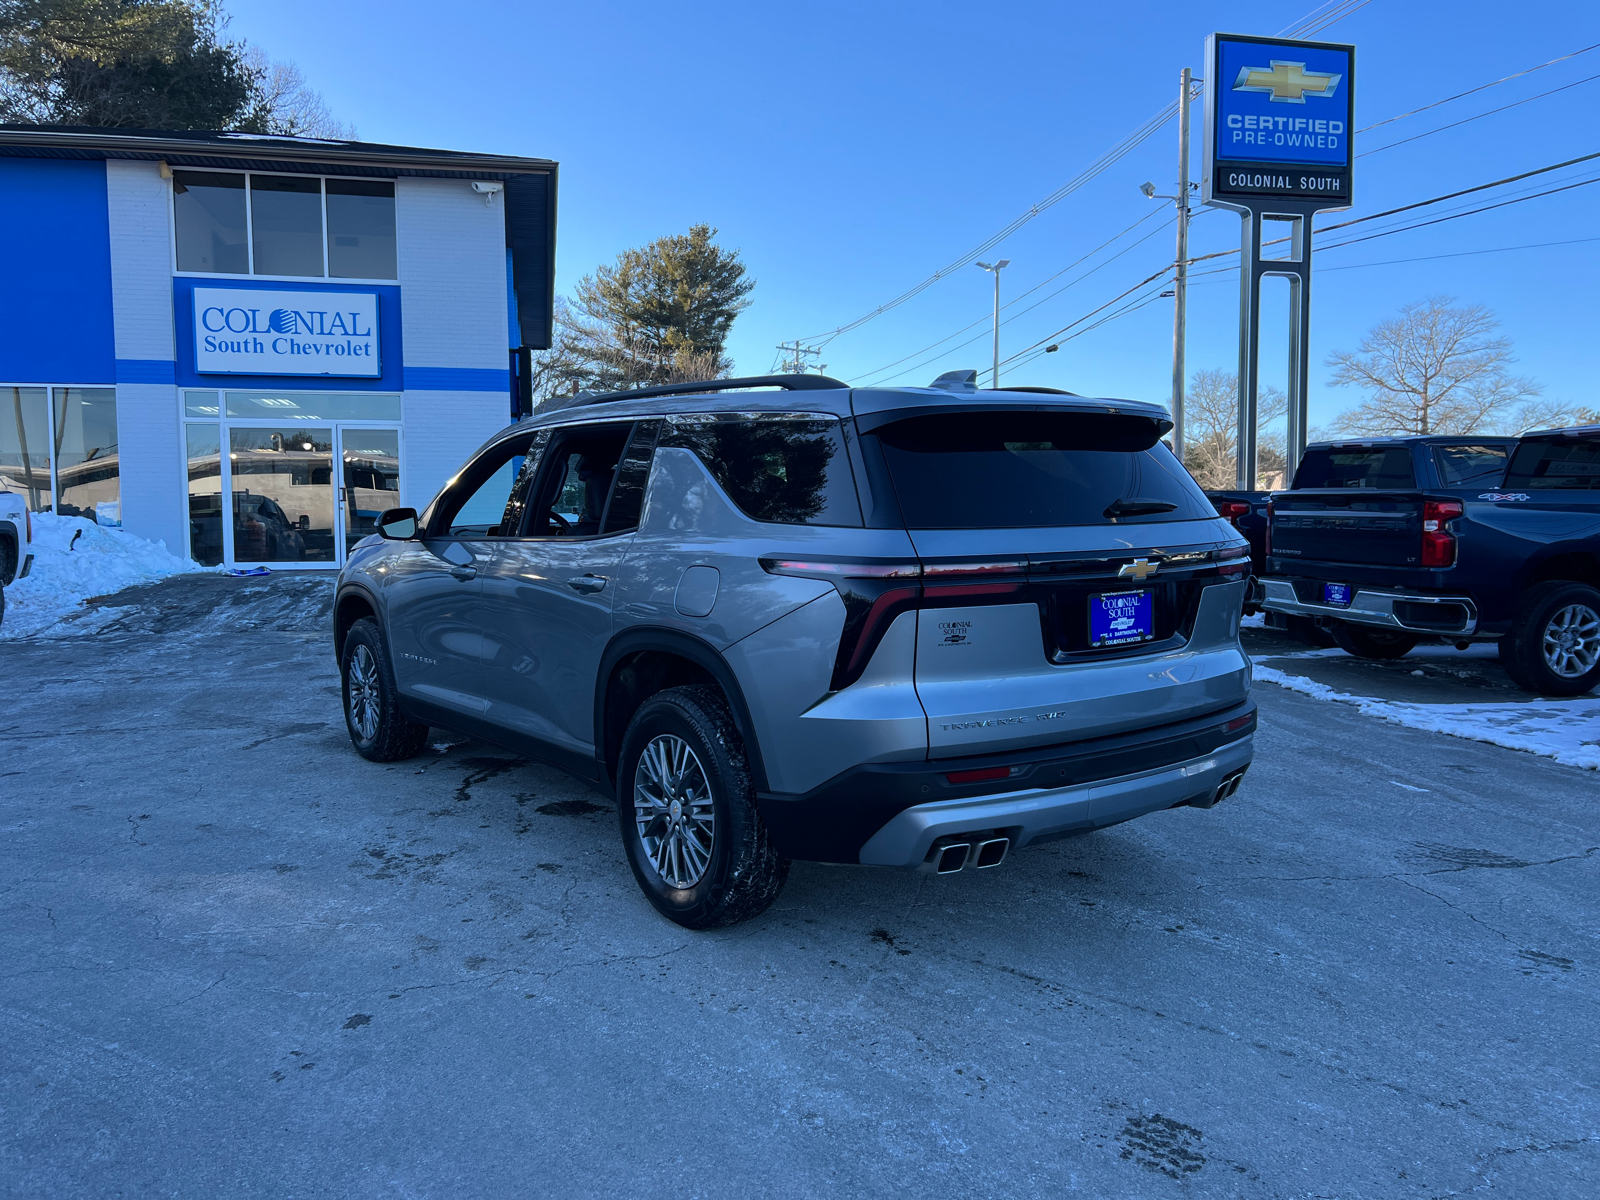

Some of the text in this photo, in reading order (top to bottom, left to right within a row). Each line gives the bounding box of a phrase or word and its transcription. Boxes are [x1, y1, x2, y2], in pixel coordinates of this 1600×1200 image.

[1227, 114, 1344, 134] CERTIFIED
[1232, 131, 1338, 149] PRE-OWNED
[1229, 173, 1340, 191] COLONIAL SOUTH
[202, 306, 371, 337] COLONIAL
[204, 335, 372, 357] South Chevrolet
[1275, 517, 1406, 532] CHEVROLET
[1102, 597, 1140, 609] COLONIAL
[1109, 607, 1135, 618] SOUTH
[938, 621, 973, 630] COLONIAL
[943, 627, 967, 636] SOUTH
[1105, 637, 1126, 646] COLONIAL
[399, 652, 438, 666] TRAVERSE
[940, 710, 1066, 731] TRAVERSE AWD
